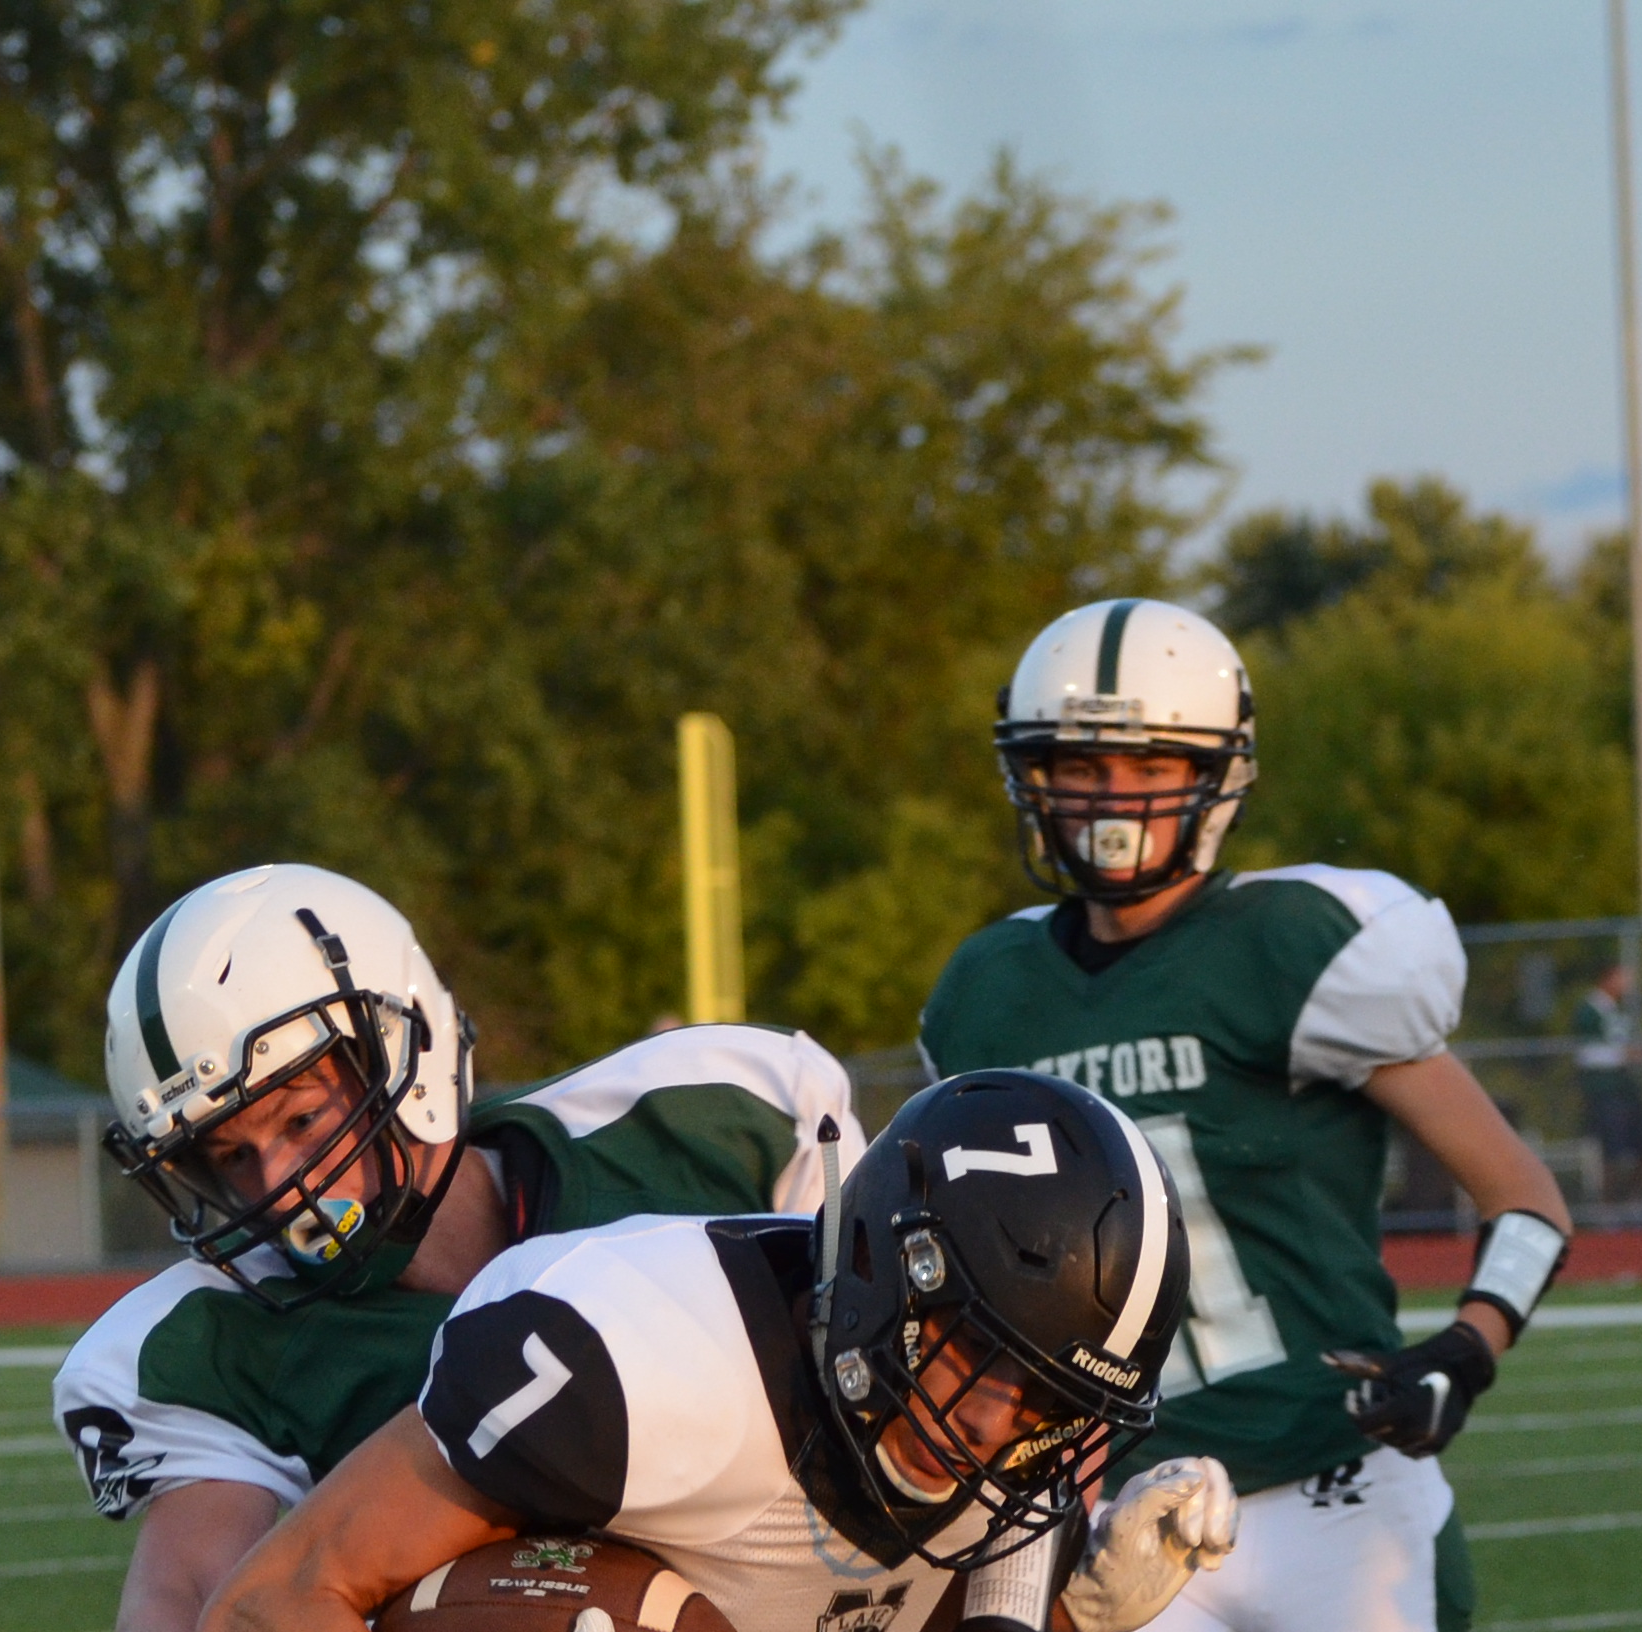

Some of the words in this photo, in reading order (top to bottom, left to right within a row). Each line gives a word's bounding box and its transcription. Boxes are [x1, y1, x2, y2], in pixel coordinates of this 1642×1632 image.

[942, 1123, 1058, 1182] 7
[1071, 1347, 1141, 1390] Riddell
[467, 1331, 573, 1460] 7
[489, 1578, 536, 1588] TEAM
[538, 1580, 591, 1594] ISSUE
